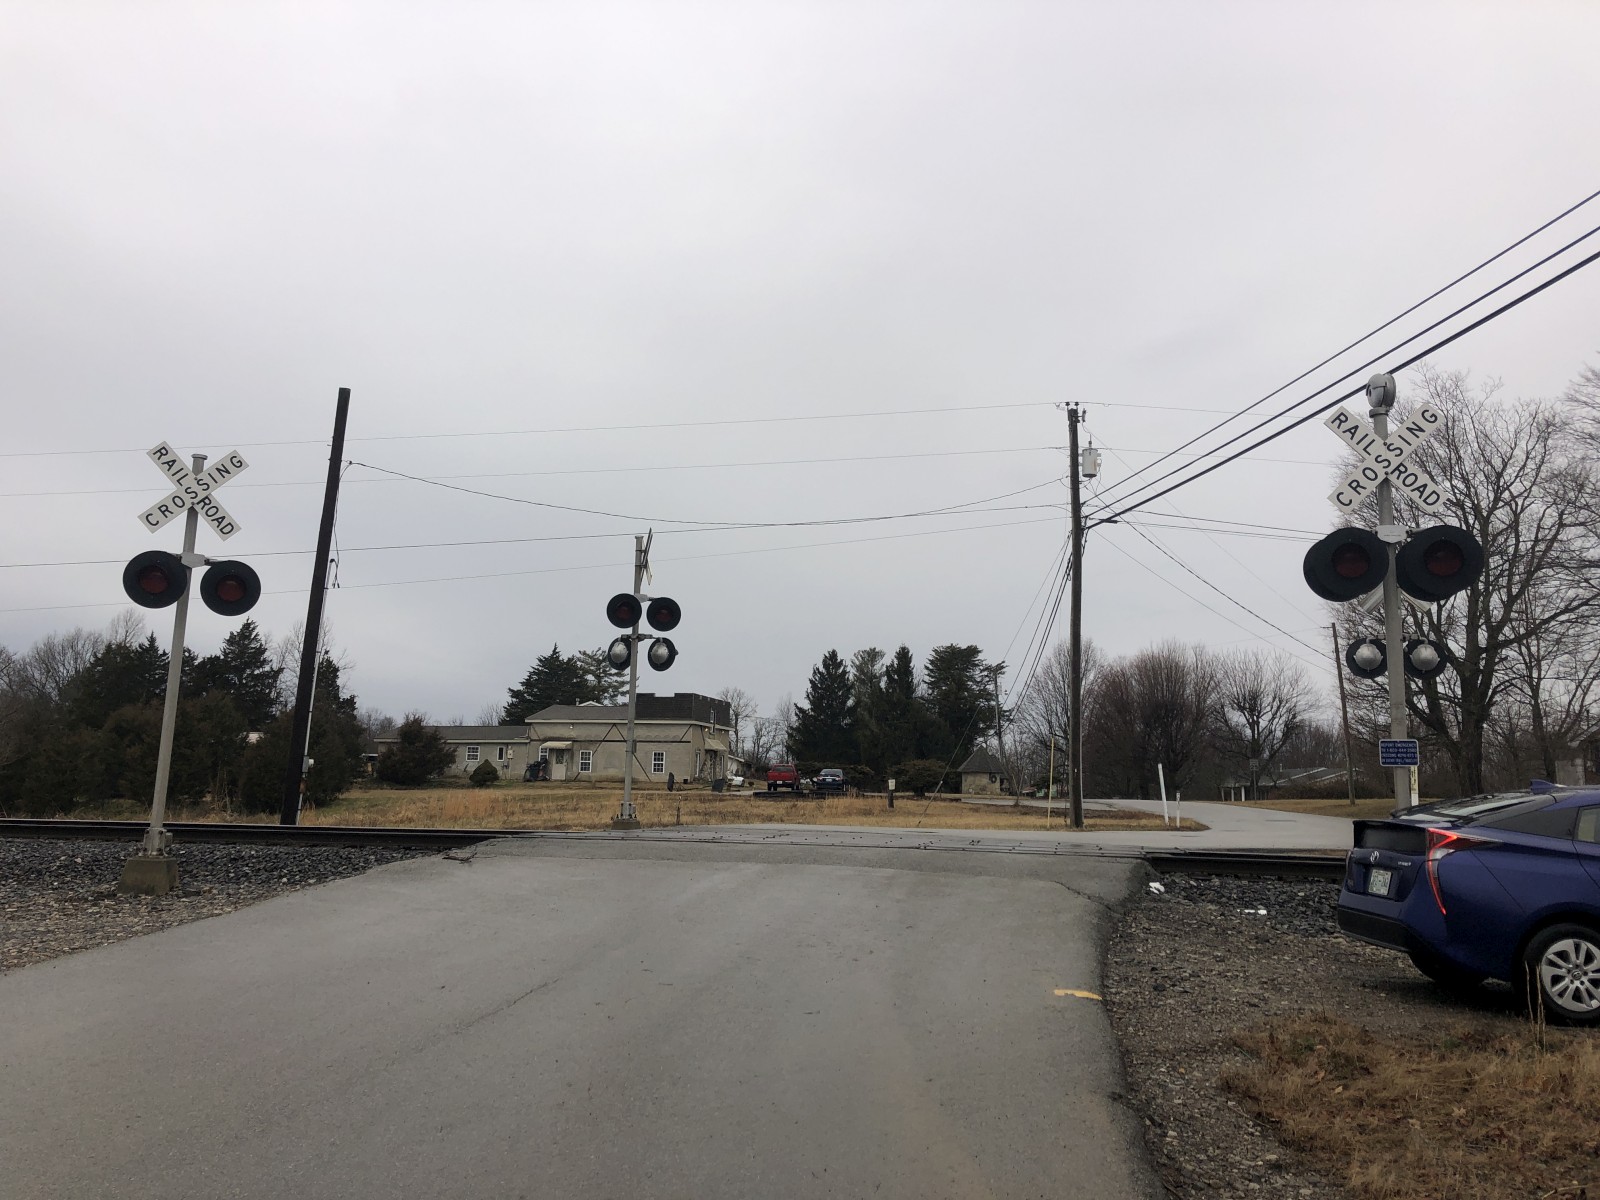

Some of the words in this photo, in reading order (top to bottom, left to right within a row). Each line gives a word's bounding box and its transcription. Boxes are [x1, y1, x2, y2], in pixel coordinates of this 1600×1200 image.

[145, 455, 243, 527] CROSSING
[152, 446, 189, 487] RAIL
[196, 495, 235, 535] ROAD
[1331, 411, 1376, 456] RAIL
[1390, 462, 1441, 506] ROAD
[1336, 409, 1438, 507] CROSSING
